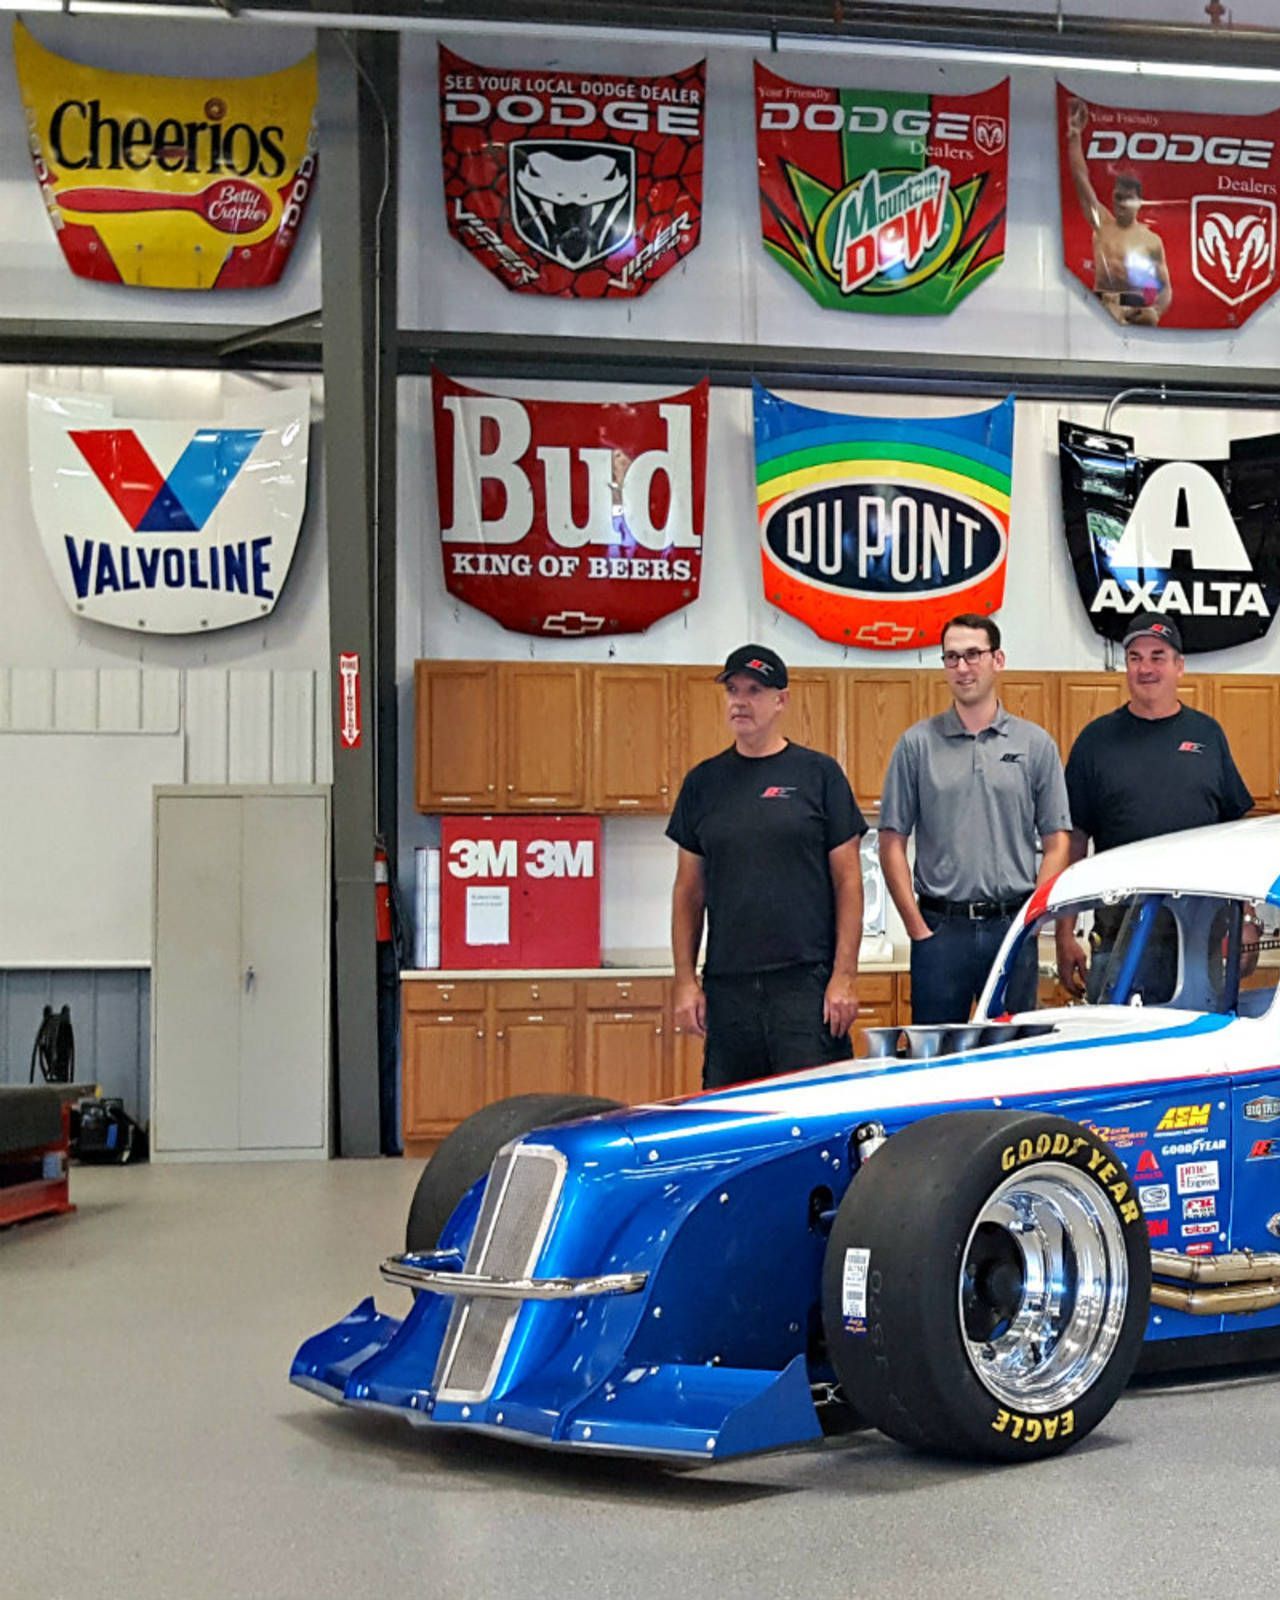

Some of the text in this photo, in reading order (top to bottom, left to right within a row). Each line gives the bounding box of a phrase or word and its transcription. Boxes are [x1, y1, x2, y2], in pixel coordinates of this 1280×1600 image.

[445, 75, 700, 104] SEE YOUR LOCAL DODGE DEALER
[785, 87, 831, 101] Friendly
[445, 93, 700, 136] DODGE
[760, 102, 971, 141] DODGE
[49, 98, 286, 178] Cheerios
[910, 140, 975, 161] Dealers
[1087, 131, 1275, 168] DODGE
[220, 185, 260, 208] Betty
[1217, 176, 1278, 195] Dealers
[835, 166, 944, 268] Mountain
[607, 210, 693, 291] VIPER
[442, 395, 702, 551] Bud
[1109, 461, 1253, 572] A
[64, 534, 274, 600] VALVOLINE
[452, 553, 533, 577] KING
[538, 556, 580, 578] OF
[1090, 579, 1270, 617] AXALTA
[448, 839, 517, 879] 3M
[524, 839, 594, 879] 3M
[1155, 1103, 1212, 1131] AEM
[1161, 1137, 1227, 1157] GOODYEAR
[1001, 1133, 1140, 1226] GOODYEAR
[991, 1408, 1075, 1443] EAGLE
